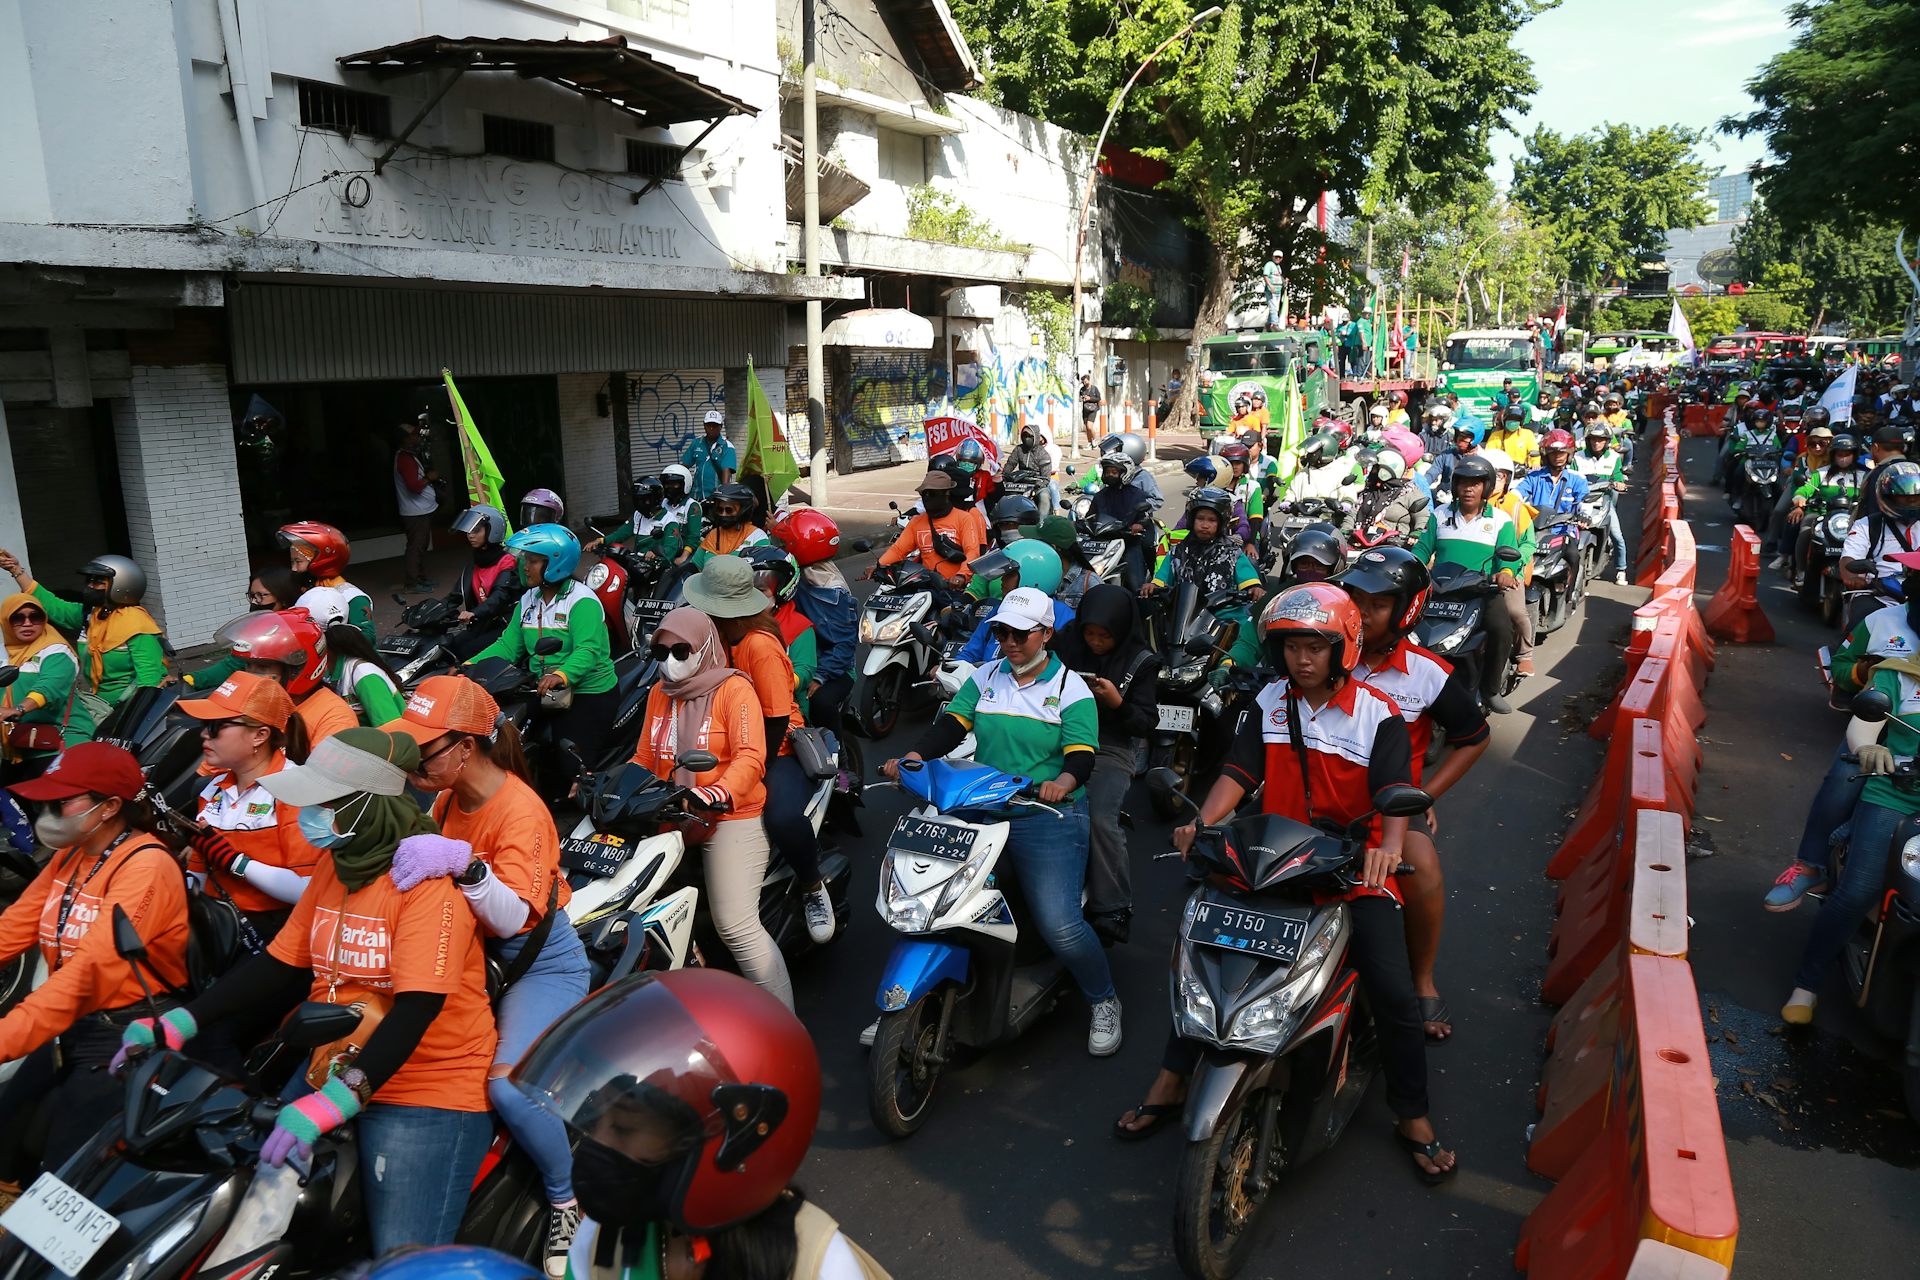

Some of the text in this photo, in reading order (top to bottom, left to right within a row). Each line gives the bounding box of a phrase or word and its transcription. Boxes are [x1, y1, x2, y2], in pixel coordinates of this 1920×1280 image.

[616, 223, 681, 259] ANTIK
[927, 421, 949, 448] FSB
[1297, 608, 1330, 625] PISTON
[897, 818, 909, 832] W
[915, 822, 948, 839] 4769
[560, 838, 567, 850] W
[568, 839, 597, 856] 2680
[1249, 846, 1277, 855] HONDA
[665, 899, 690, 924] HONDA
[970, 897, 998, 921] HONDA
[336, 921, 386, 948] artai
[1197, 906, 1305, 941] N 5150 TV
[435, 901, 454, 977] MAYDAY 2023
[42, 1185, 84, 1223] 4968
[75, 1210, 113, 1244] NFC
